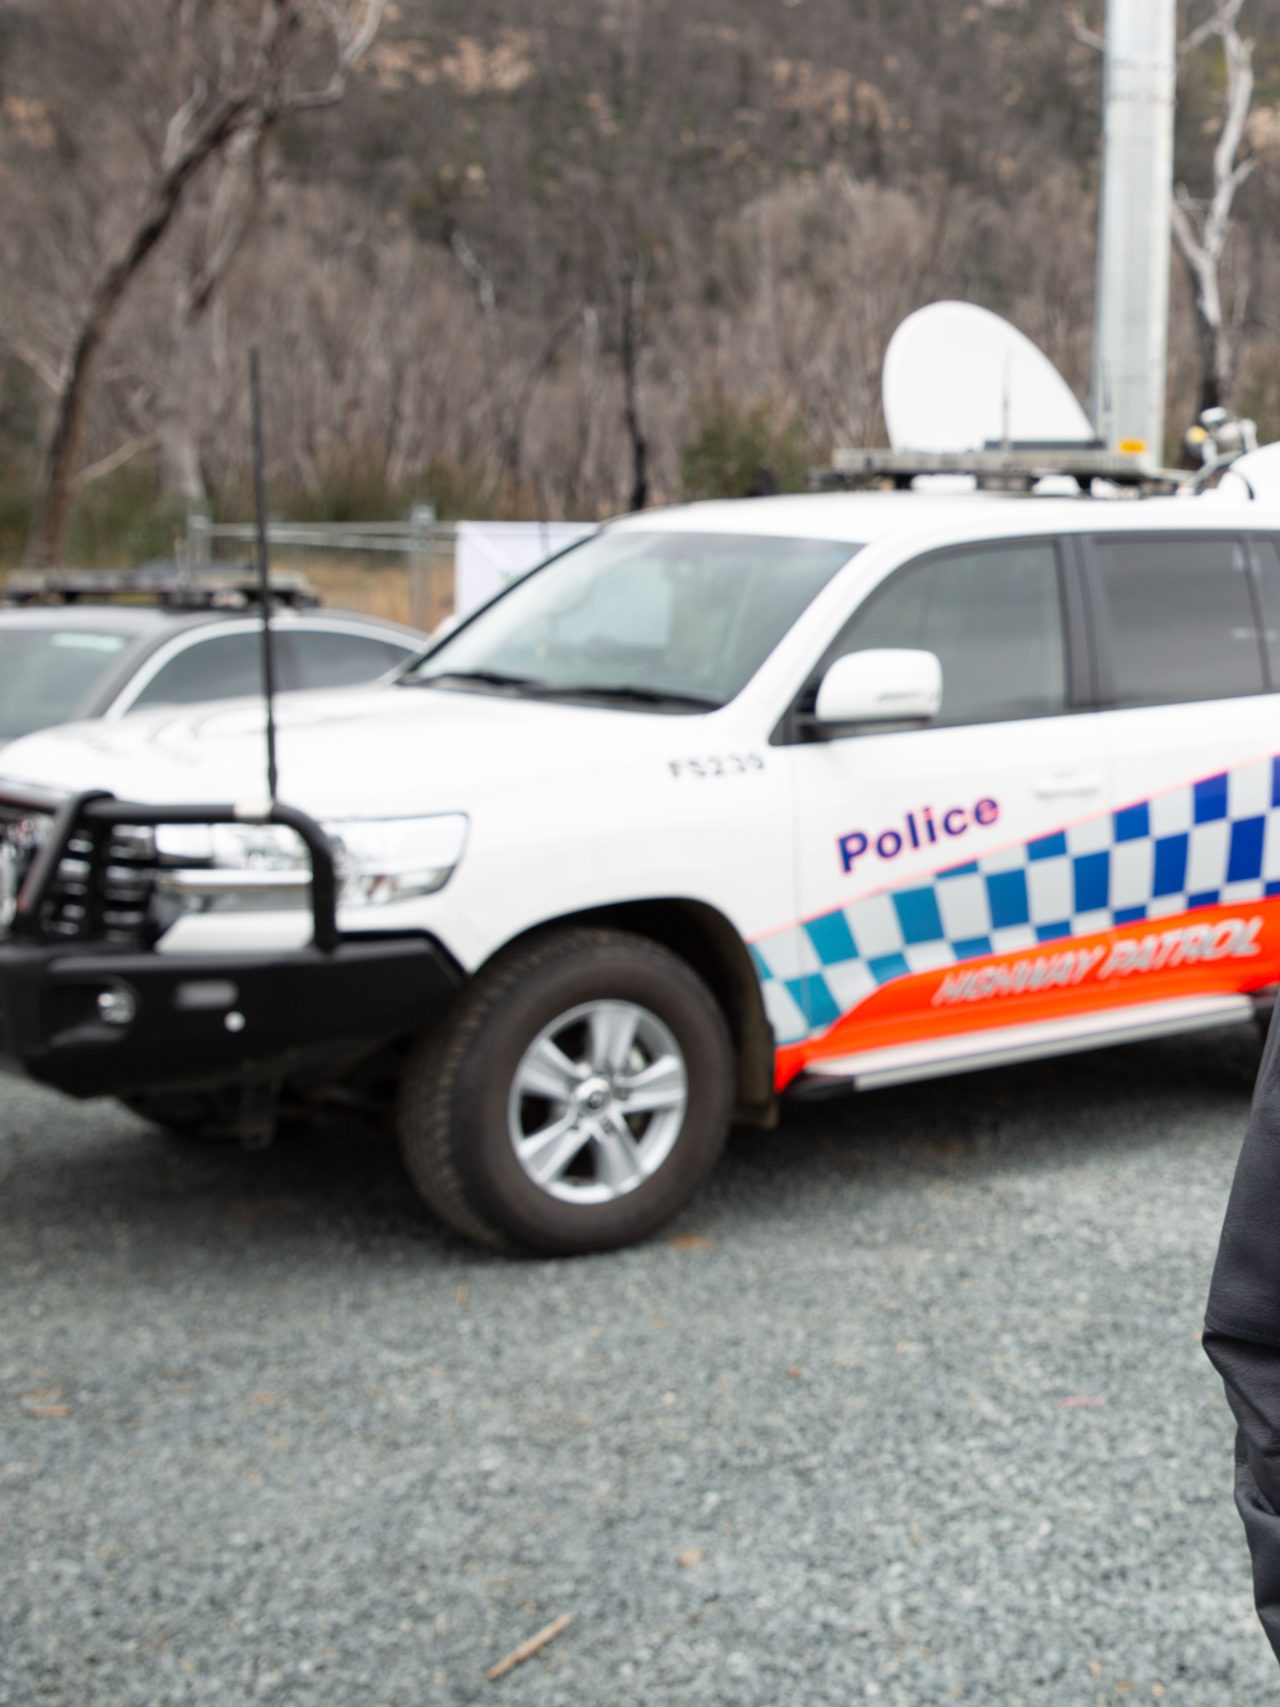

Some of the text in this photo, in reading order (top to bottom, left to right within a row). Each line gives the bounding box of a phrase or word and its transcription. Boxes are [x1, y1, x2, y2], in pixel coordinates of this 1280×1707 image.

[838, 799, 1000, 872] Police
[933, 917, 1262, 1005] HIGHWAY PATROL
